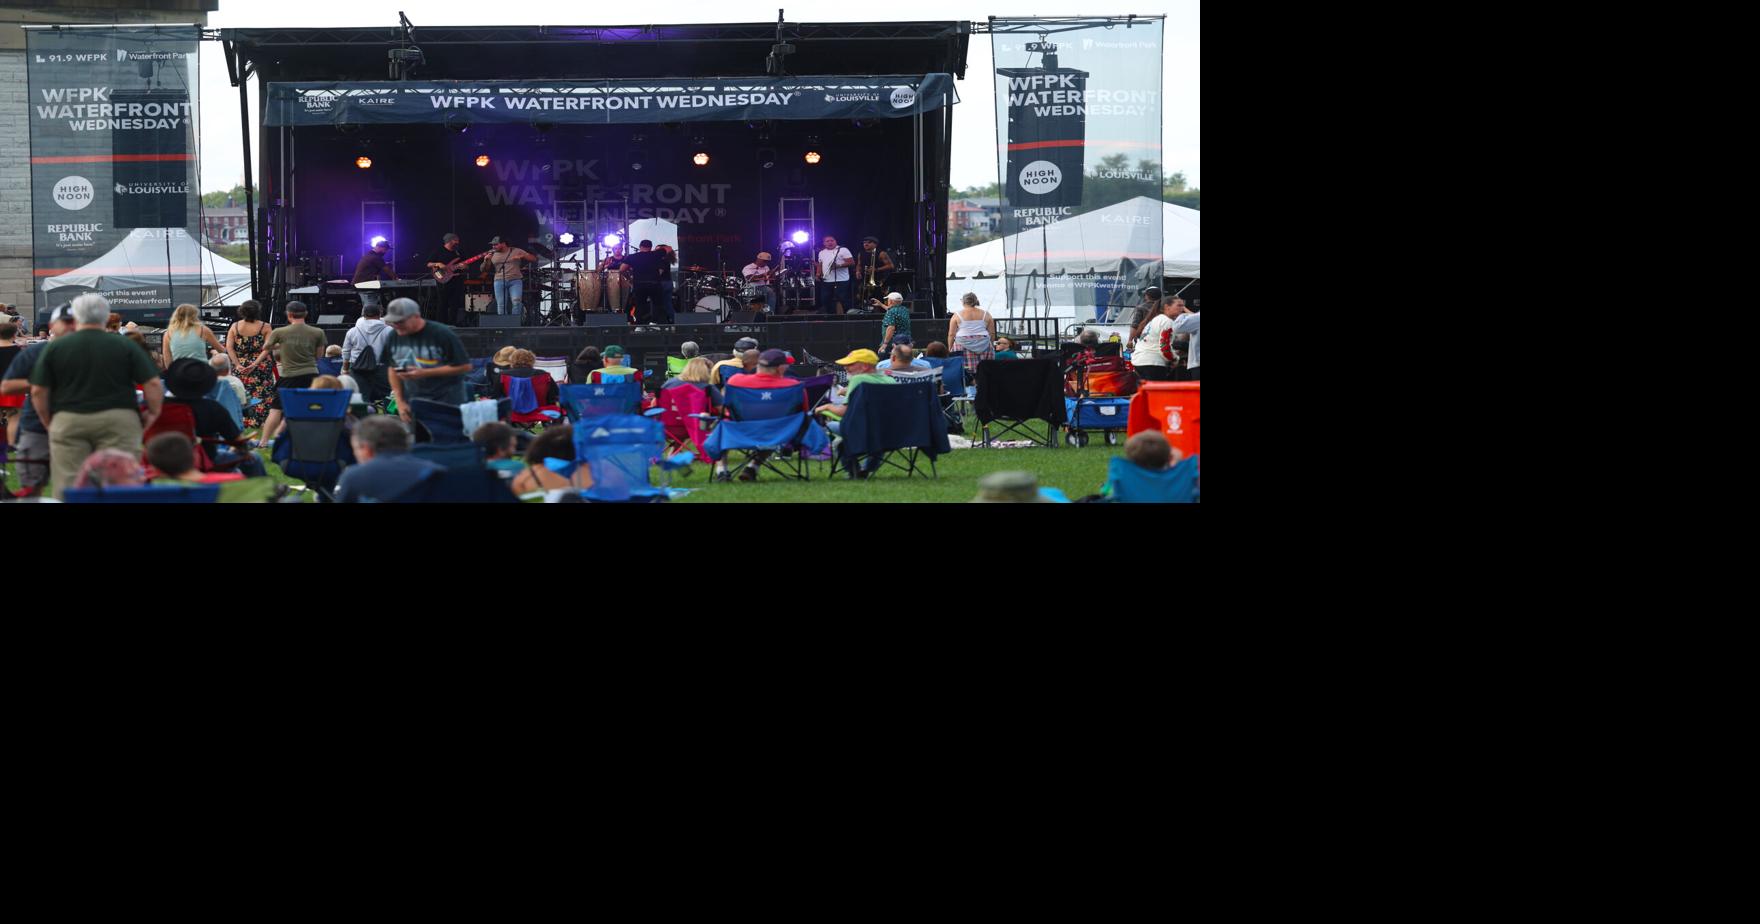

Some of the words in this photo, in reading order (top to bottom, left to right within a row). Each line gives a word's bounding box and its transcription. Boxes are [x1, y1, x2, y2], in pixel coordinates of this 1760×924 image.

[49, 54, 73, 62] 91.9
[75, 53, 107, 62] WFPK
[128, 52, 171, 60] Waterfront
[1009, 74, 1076, 91] WFPK
[41, 87, 109, 103] WFPK
[298, 95, 339, 103] REPUBLIC
[1004, 89, 1157, 107] WATERFRONT
[430, 95, 496, 110] WFPK
[504, 95, 652, 110] WATERFRONT
[37, 102, 192, 119] WATERFRONT
[1026, 169, 1055, 178] HIGH
[1099, 171, 1153, 181] LOUISVILLE
[1023, 177, 1058, 186] NOON
[128, 186, 190, 194] LOUISVILLE
[57, 193, 90, 201] NOON
[1013, 206, 1072, 218] REPUBLIC
[1025, 215, 1060, 226] BANK
[1101, 214, 1151, 225] KAIRE
[48, 223, 104, 233] REPUBLIC
[59, 232, 93, 242] BANK
[1048, 273, 1084, 282] Support
